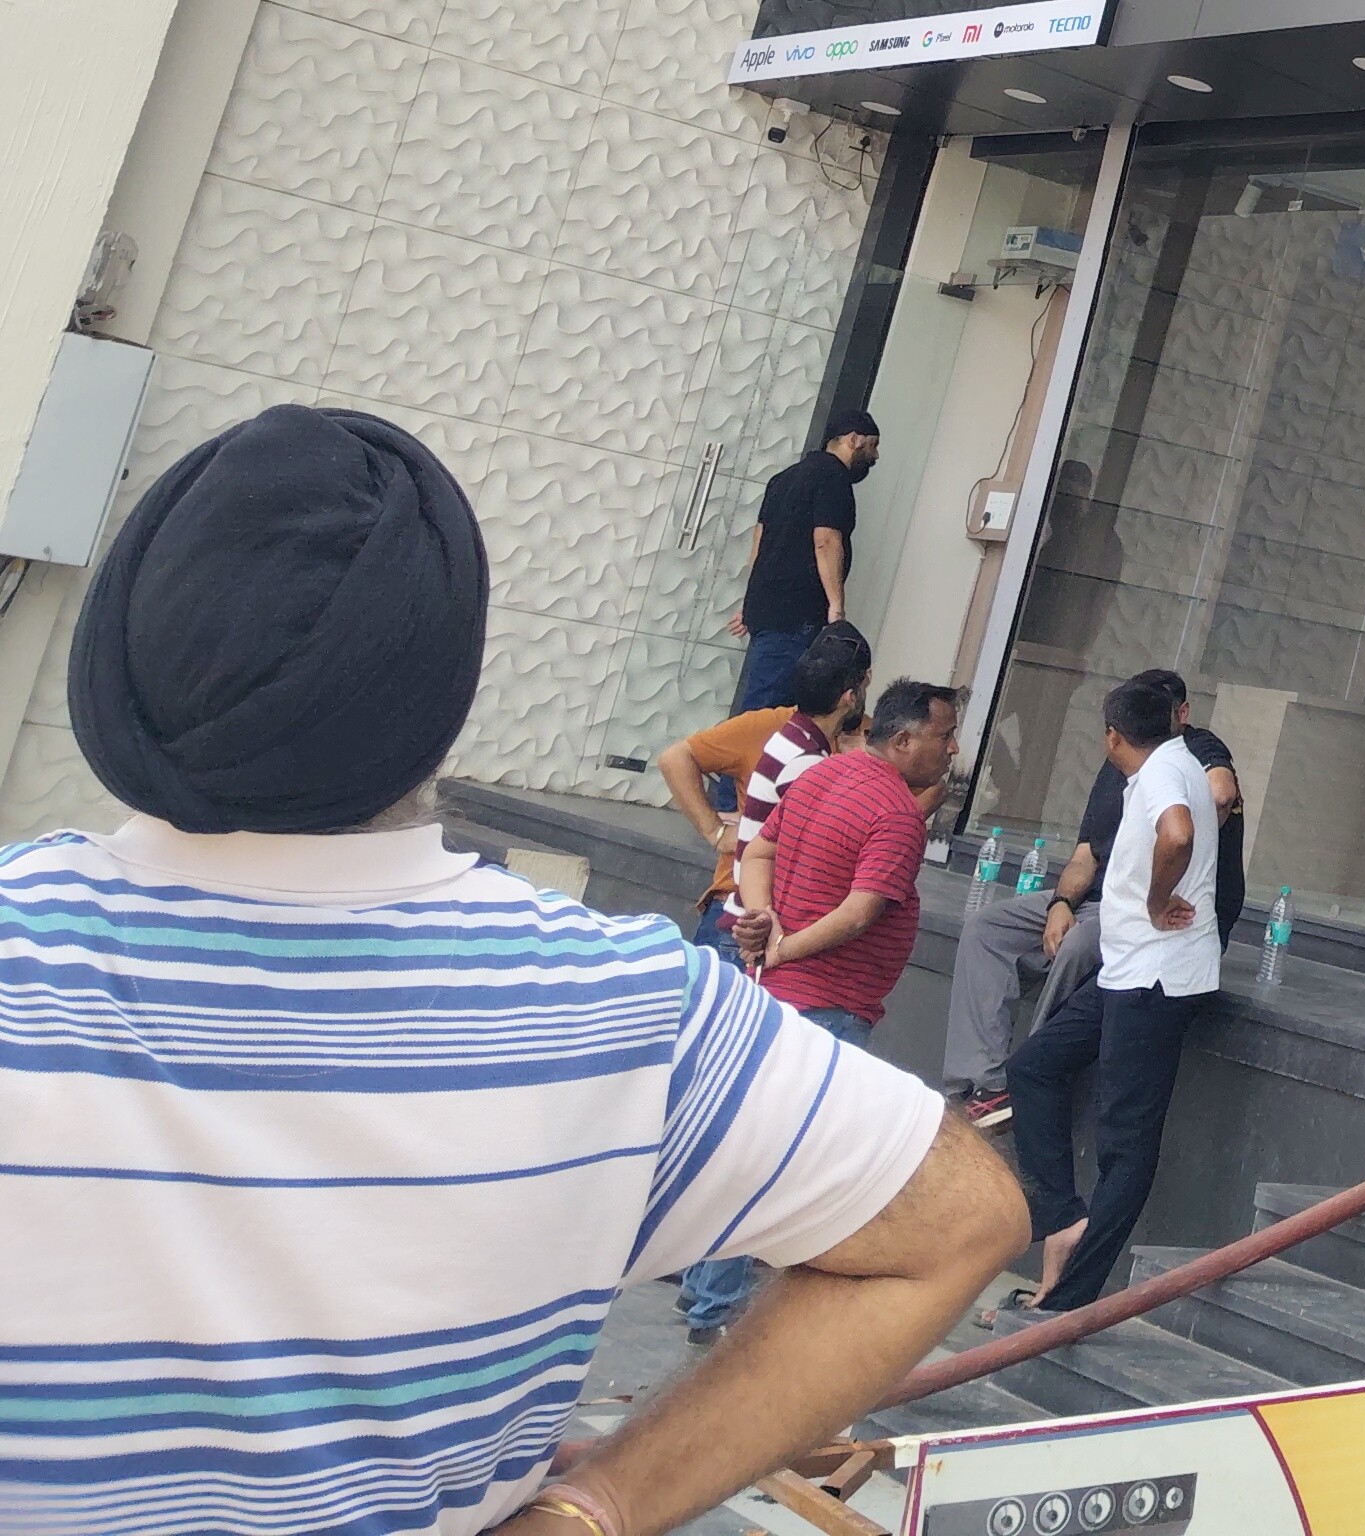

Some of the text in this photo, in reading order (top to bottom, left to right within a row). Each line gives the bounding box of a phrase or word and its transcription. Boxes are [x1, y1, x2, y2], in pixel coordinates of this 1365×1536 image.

[740, 44, 776, 72] Apple
[785, 44, 816, 62] vivo
[868, 35, 911, 53] SAMSUNG
[1003, 21, 1035, 35] motorola
[1048, 15, 1092, 34] TECNO
